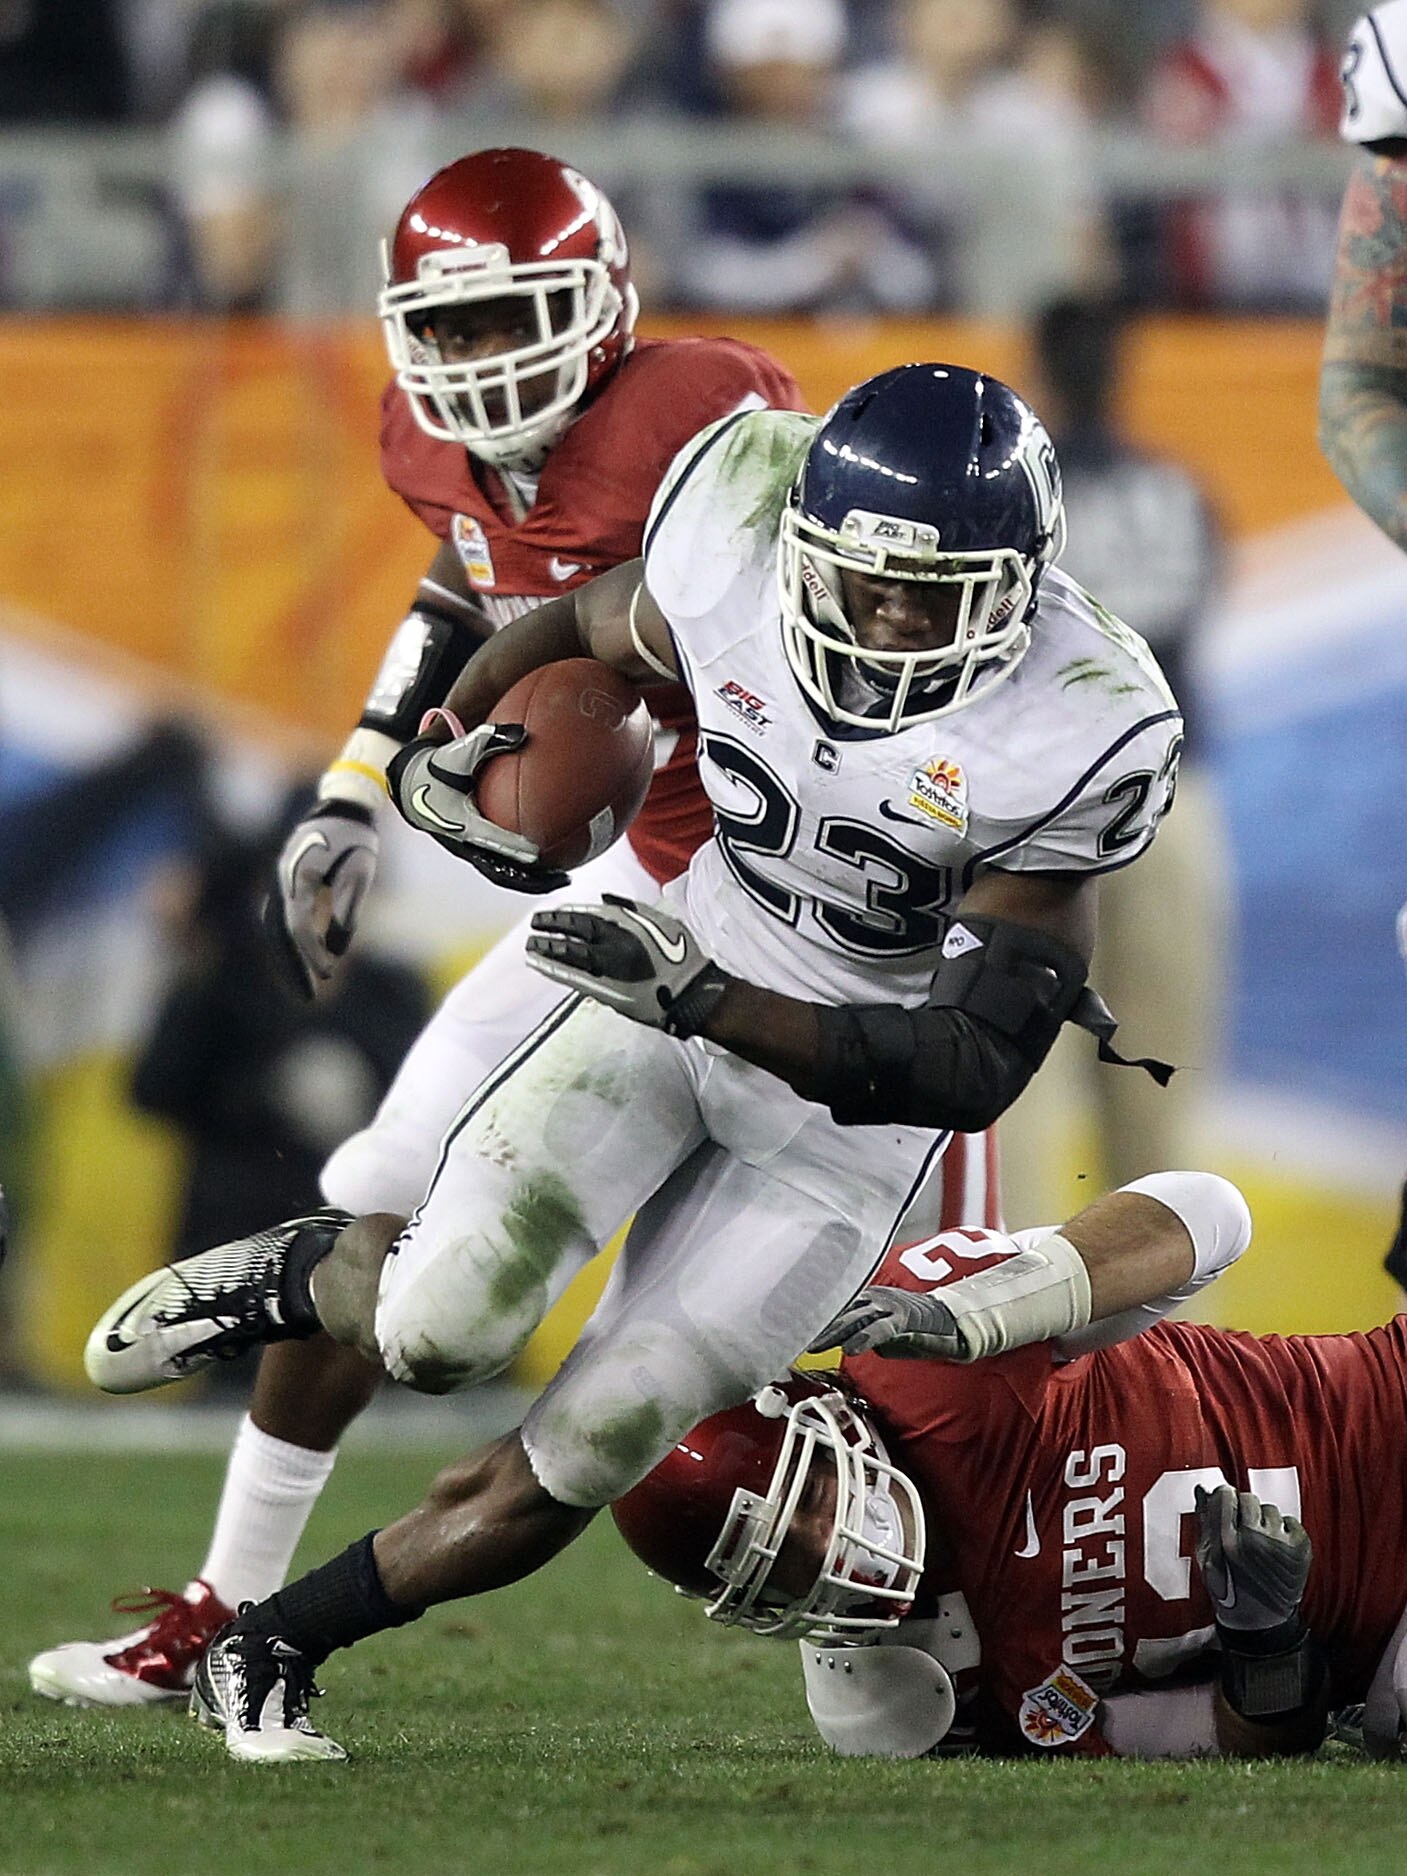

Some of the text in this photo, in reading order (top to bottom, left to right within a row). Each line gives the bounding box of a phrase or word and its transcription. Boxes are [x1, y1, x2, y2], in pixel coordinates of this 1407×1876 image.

[716, 687, 774, 726] EAST
[723, 680, 767, 711] BIG
[811, 739, 841, 774] C
[697, 727, 954, 958] 23
